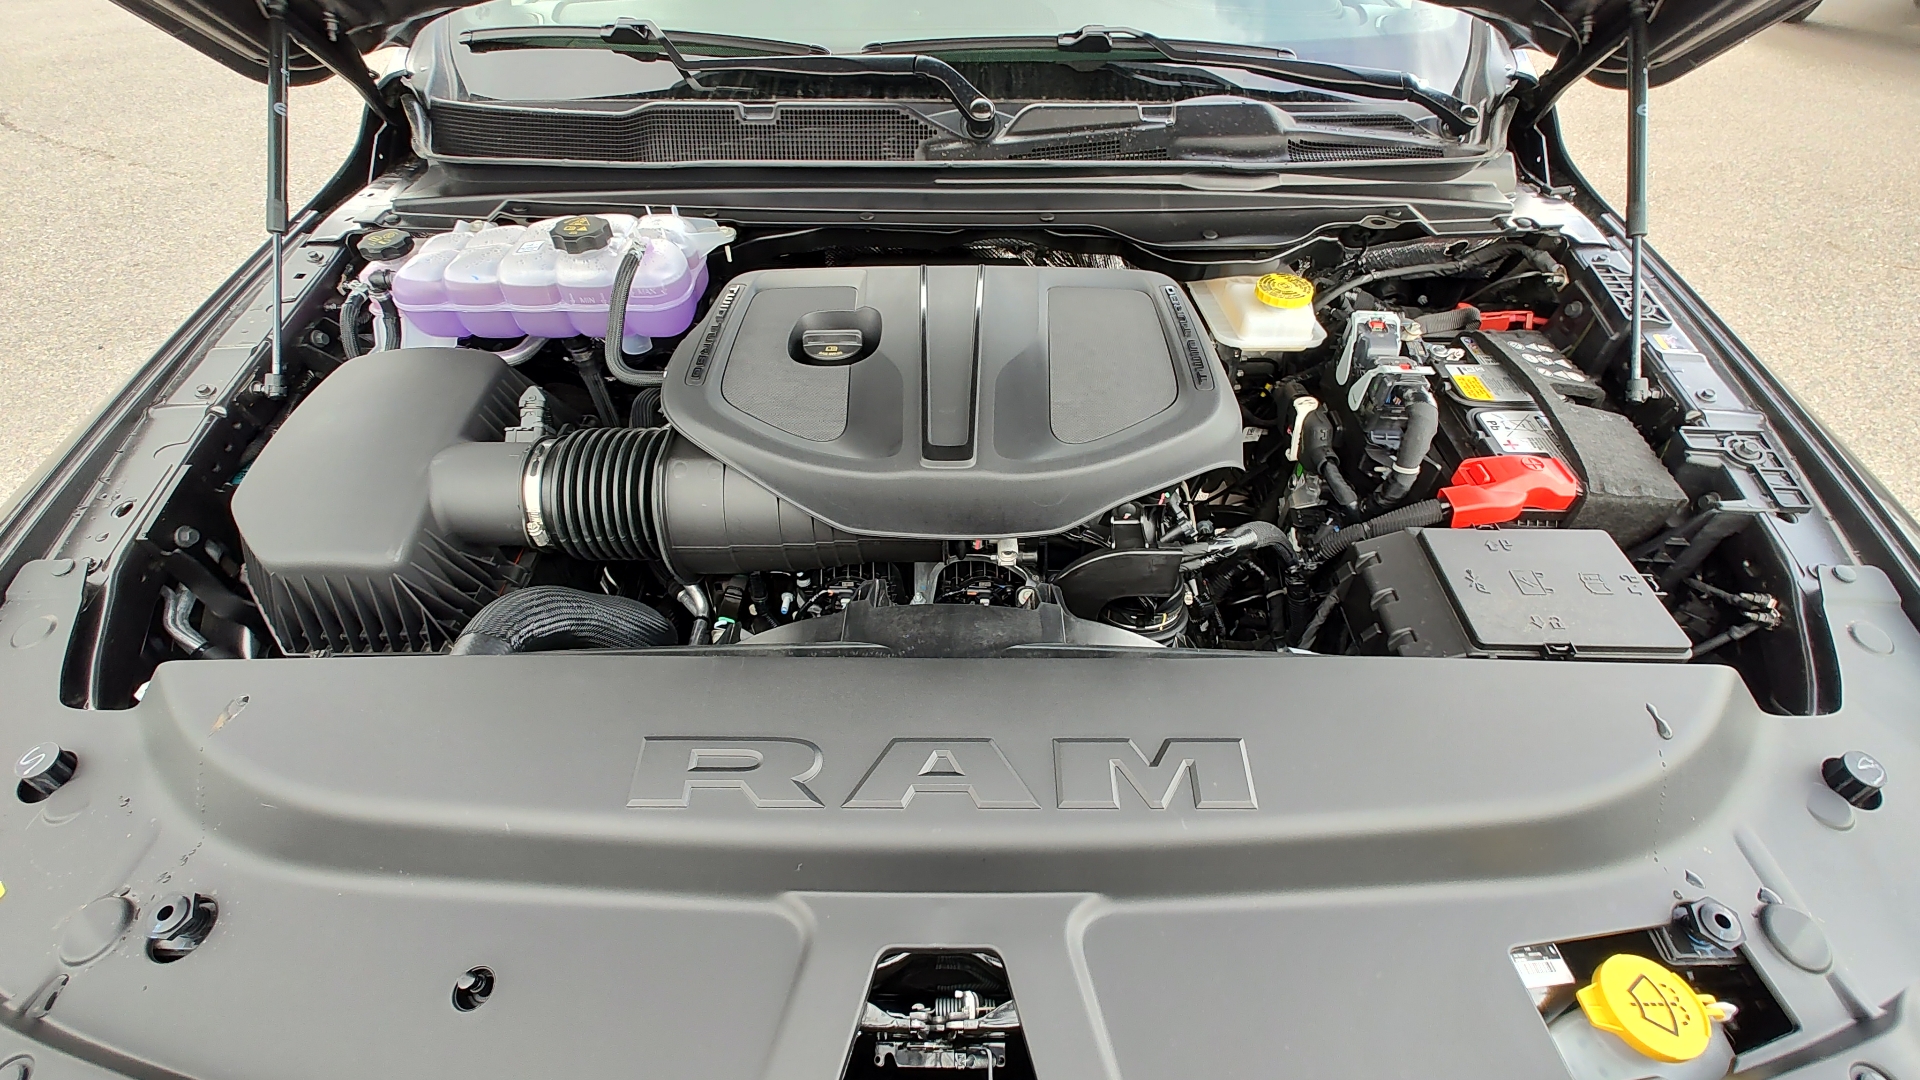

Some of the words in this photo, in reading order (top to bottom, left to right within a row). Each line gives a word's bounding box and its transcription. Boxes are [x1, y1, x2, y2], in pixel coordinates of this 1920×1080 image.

[579, 296, 596, 304] MIN
[717, 285, 740, 323] TWIN
[1164, 285, 1192, 338] TURBO
[690, 322, 722, 380] TURBO
[1186, 339, 1208, 386] TWIN
[1487, 421, 1500, 431] Pb
[627, 736, 1259, 810] RAM
